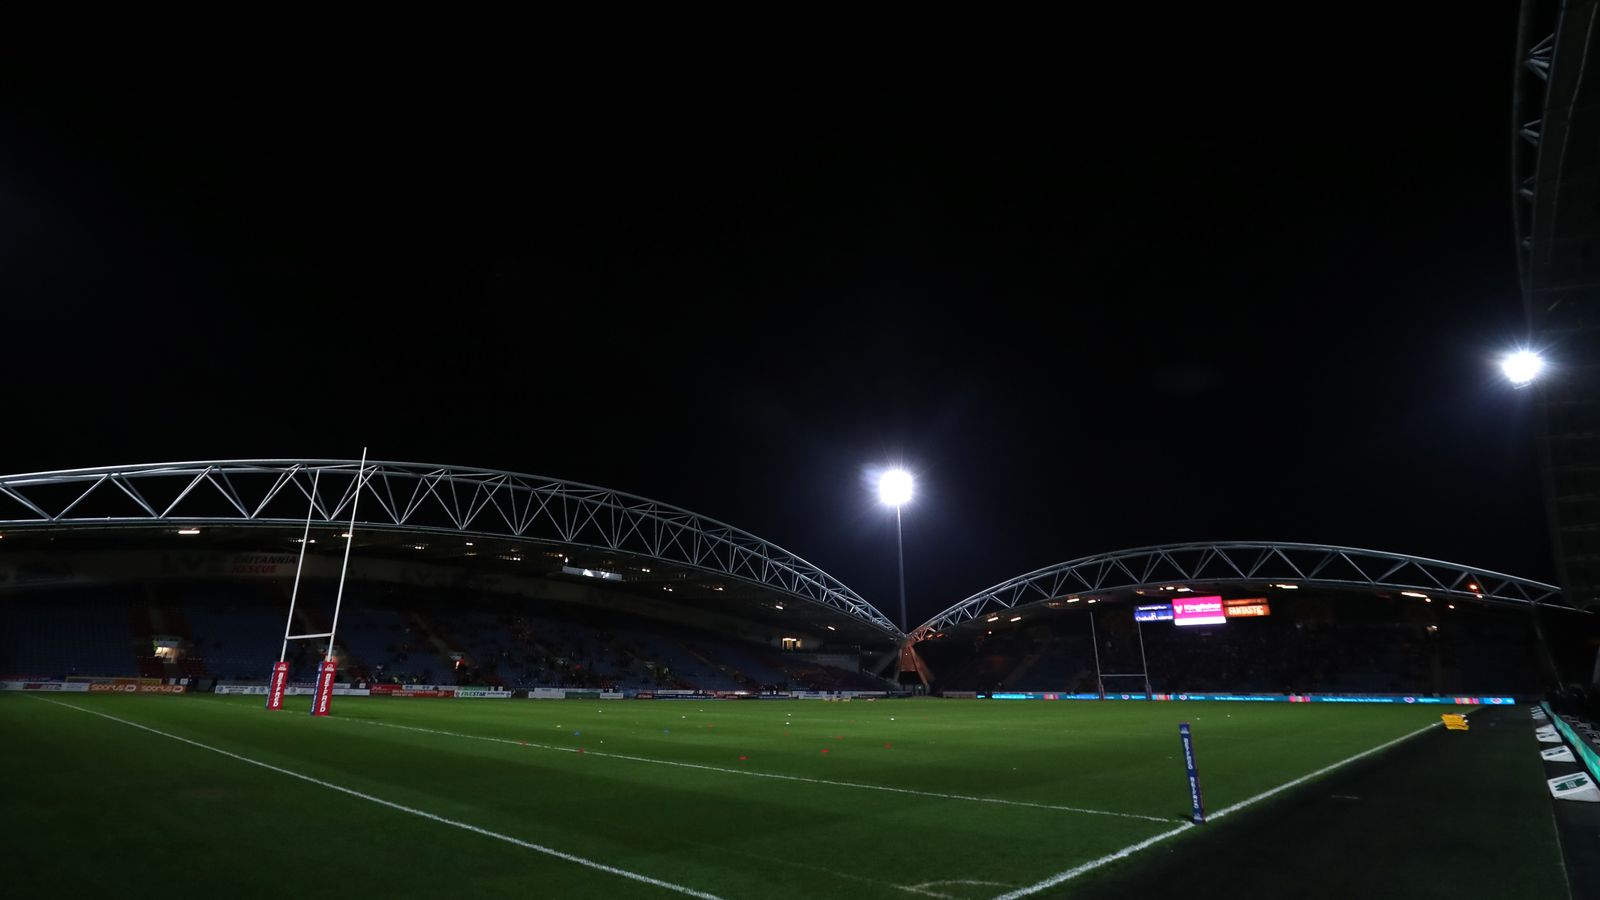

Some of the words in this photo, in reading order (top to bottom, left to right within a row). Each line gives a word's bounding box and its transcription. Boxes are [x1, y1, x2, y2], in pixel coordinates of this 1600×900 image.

[233, 555, 296, 564] BRITANNIA
[232, 564, 277, 573] RESCUE
[1228, 605, 1264, 615] FANTASTIC
[272, 672, 284, 707] BETFRED
[319, 673, 332, 712] BETFRED
